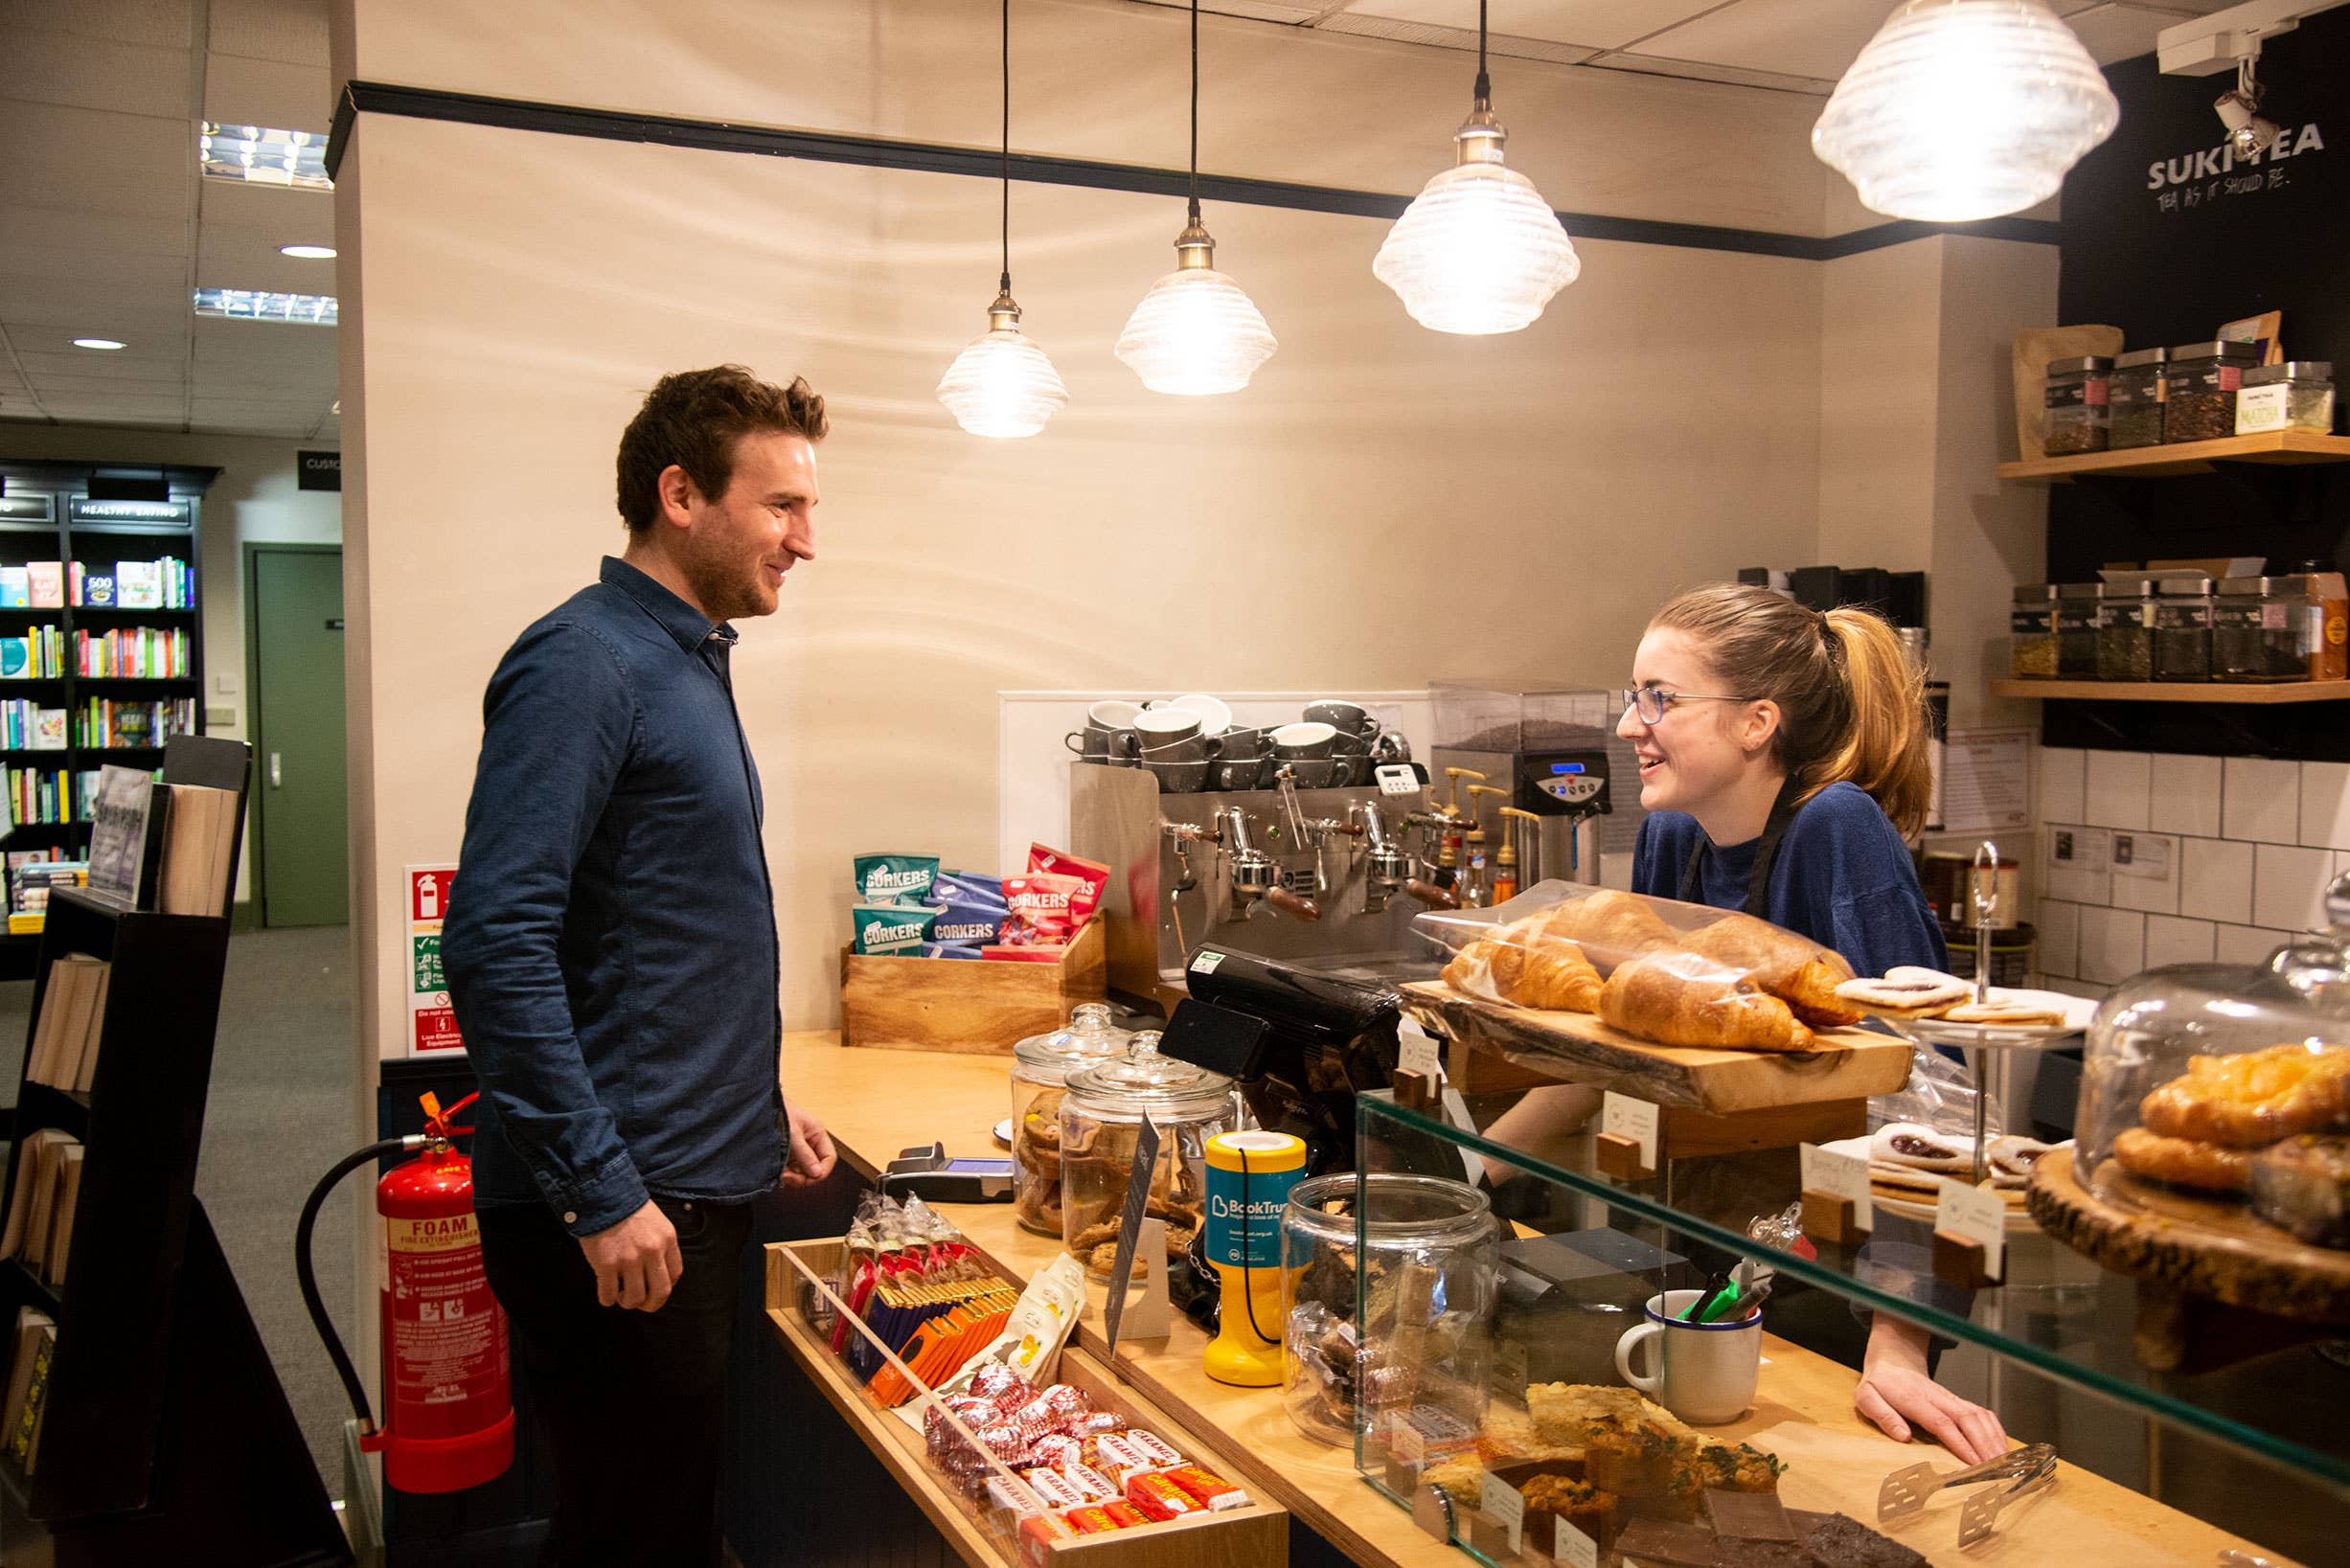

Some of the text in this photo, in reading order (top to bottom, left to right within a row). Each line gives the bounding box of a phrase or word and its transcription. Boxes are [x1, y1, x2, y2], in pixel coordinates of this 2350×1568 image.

[2147, 144, 2233, 190] SUKI
[2156, 191, 2179, 213] TEA
[2184, 186, 2202, 207] AS
[80, 505, 131, 516] HEALTHY
[866, 870, 929, 888] CORKERS
[1008, 892, 1069, 910] CORKERS
[863, 922, 924, 944] CORKERS
[934, 923, 993, 939] CORKERS
[412, 1216, 468, 1236] FOAM
[1104, 1435, 1145, 1466] CARAMEL
[1132, 1430, 1175, 1460] CARAMEL
[1037, 1470, 1080, 1503] CARAMEL
[1071, 1465, 1113, 1495] CARAMEL
[994, 1477, 1034, 1511] CARAMEL
